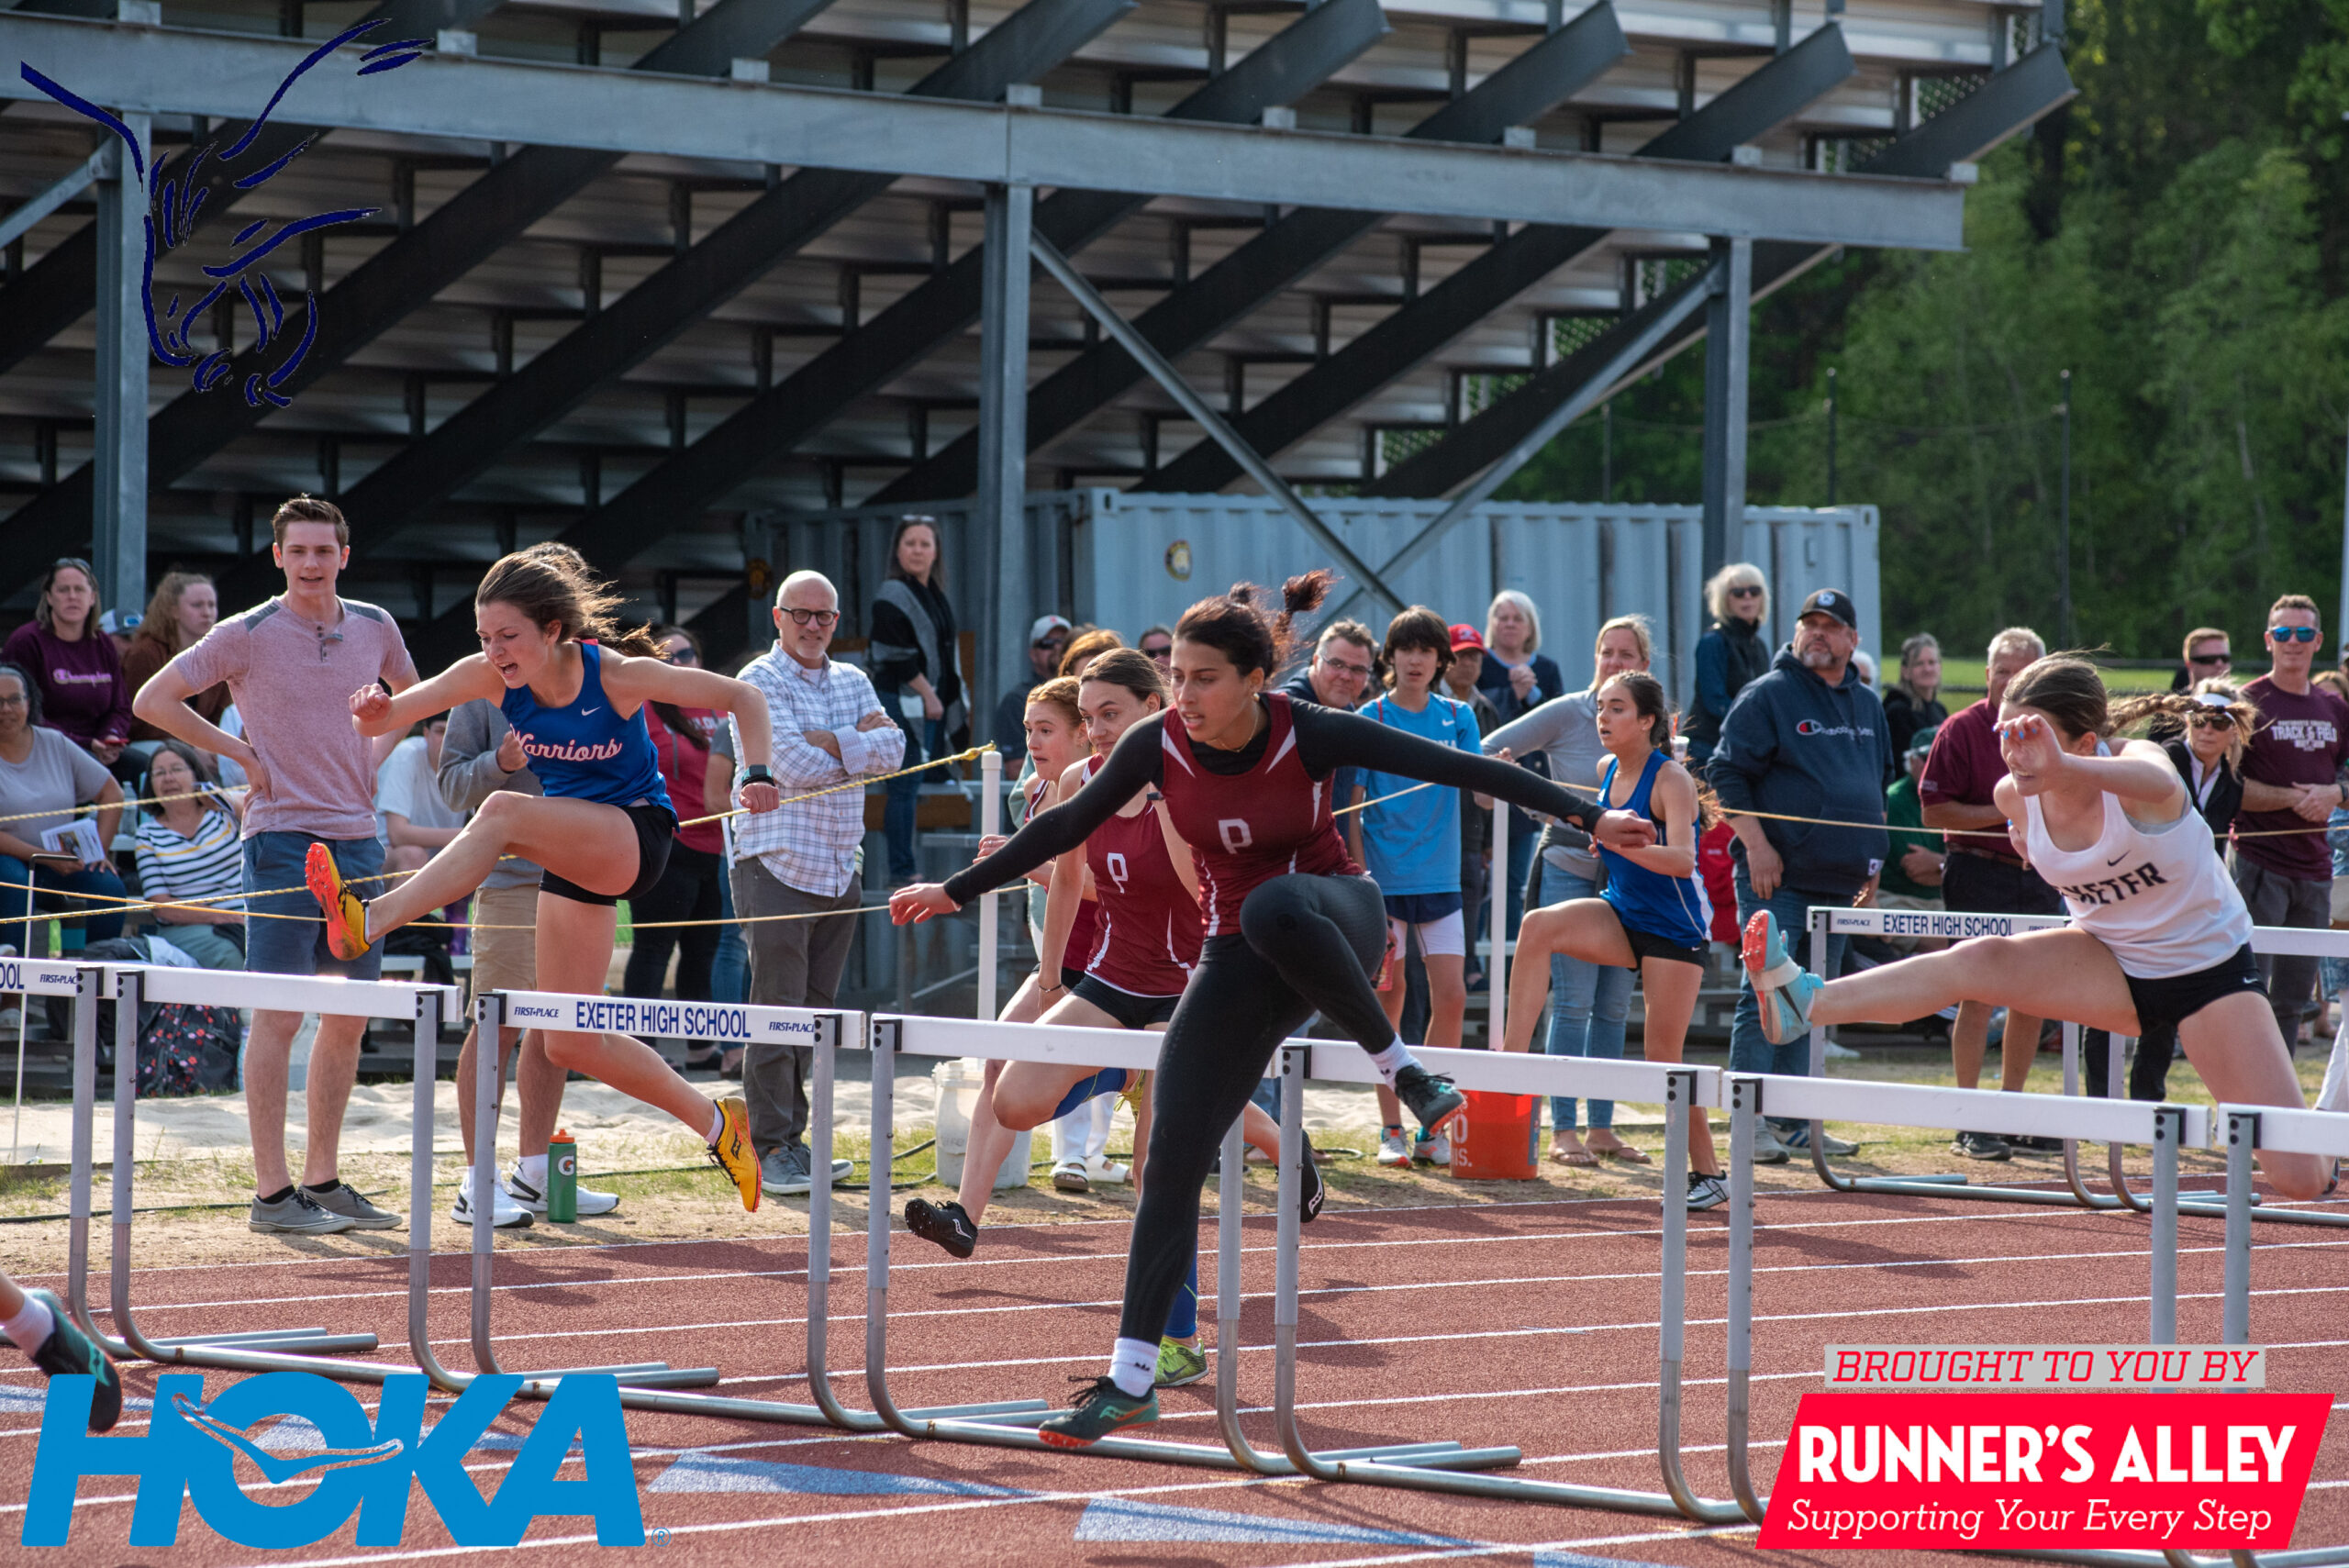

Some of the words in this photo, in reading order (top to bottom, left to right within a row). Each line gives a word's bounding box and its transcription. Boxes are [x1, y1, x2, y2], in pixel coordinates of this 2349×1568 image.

[509, 723, 623, 762] Warriors
[2270, 725, 2305, 740] TRACK
[1219, 818, 1252, 854] P
[1107, 852, 1129, 894] P
[1884, 914, 1929, 934] EXETER
[1932, 916, 1961, 935] HIGH
[576, 1001, 636, 1031] EXETER
[641, 1005, 679, 1034] HIGH
[685, 1007, 751, 1038] SCHOOL
[558, 1155, 574, 1176] G
